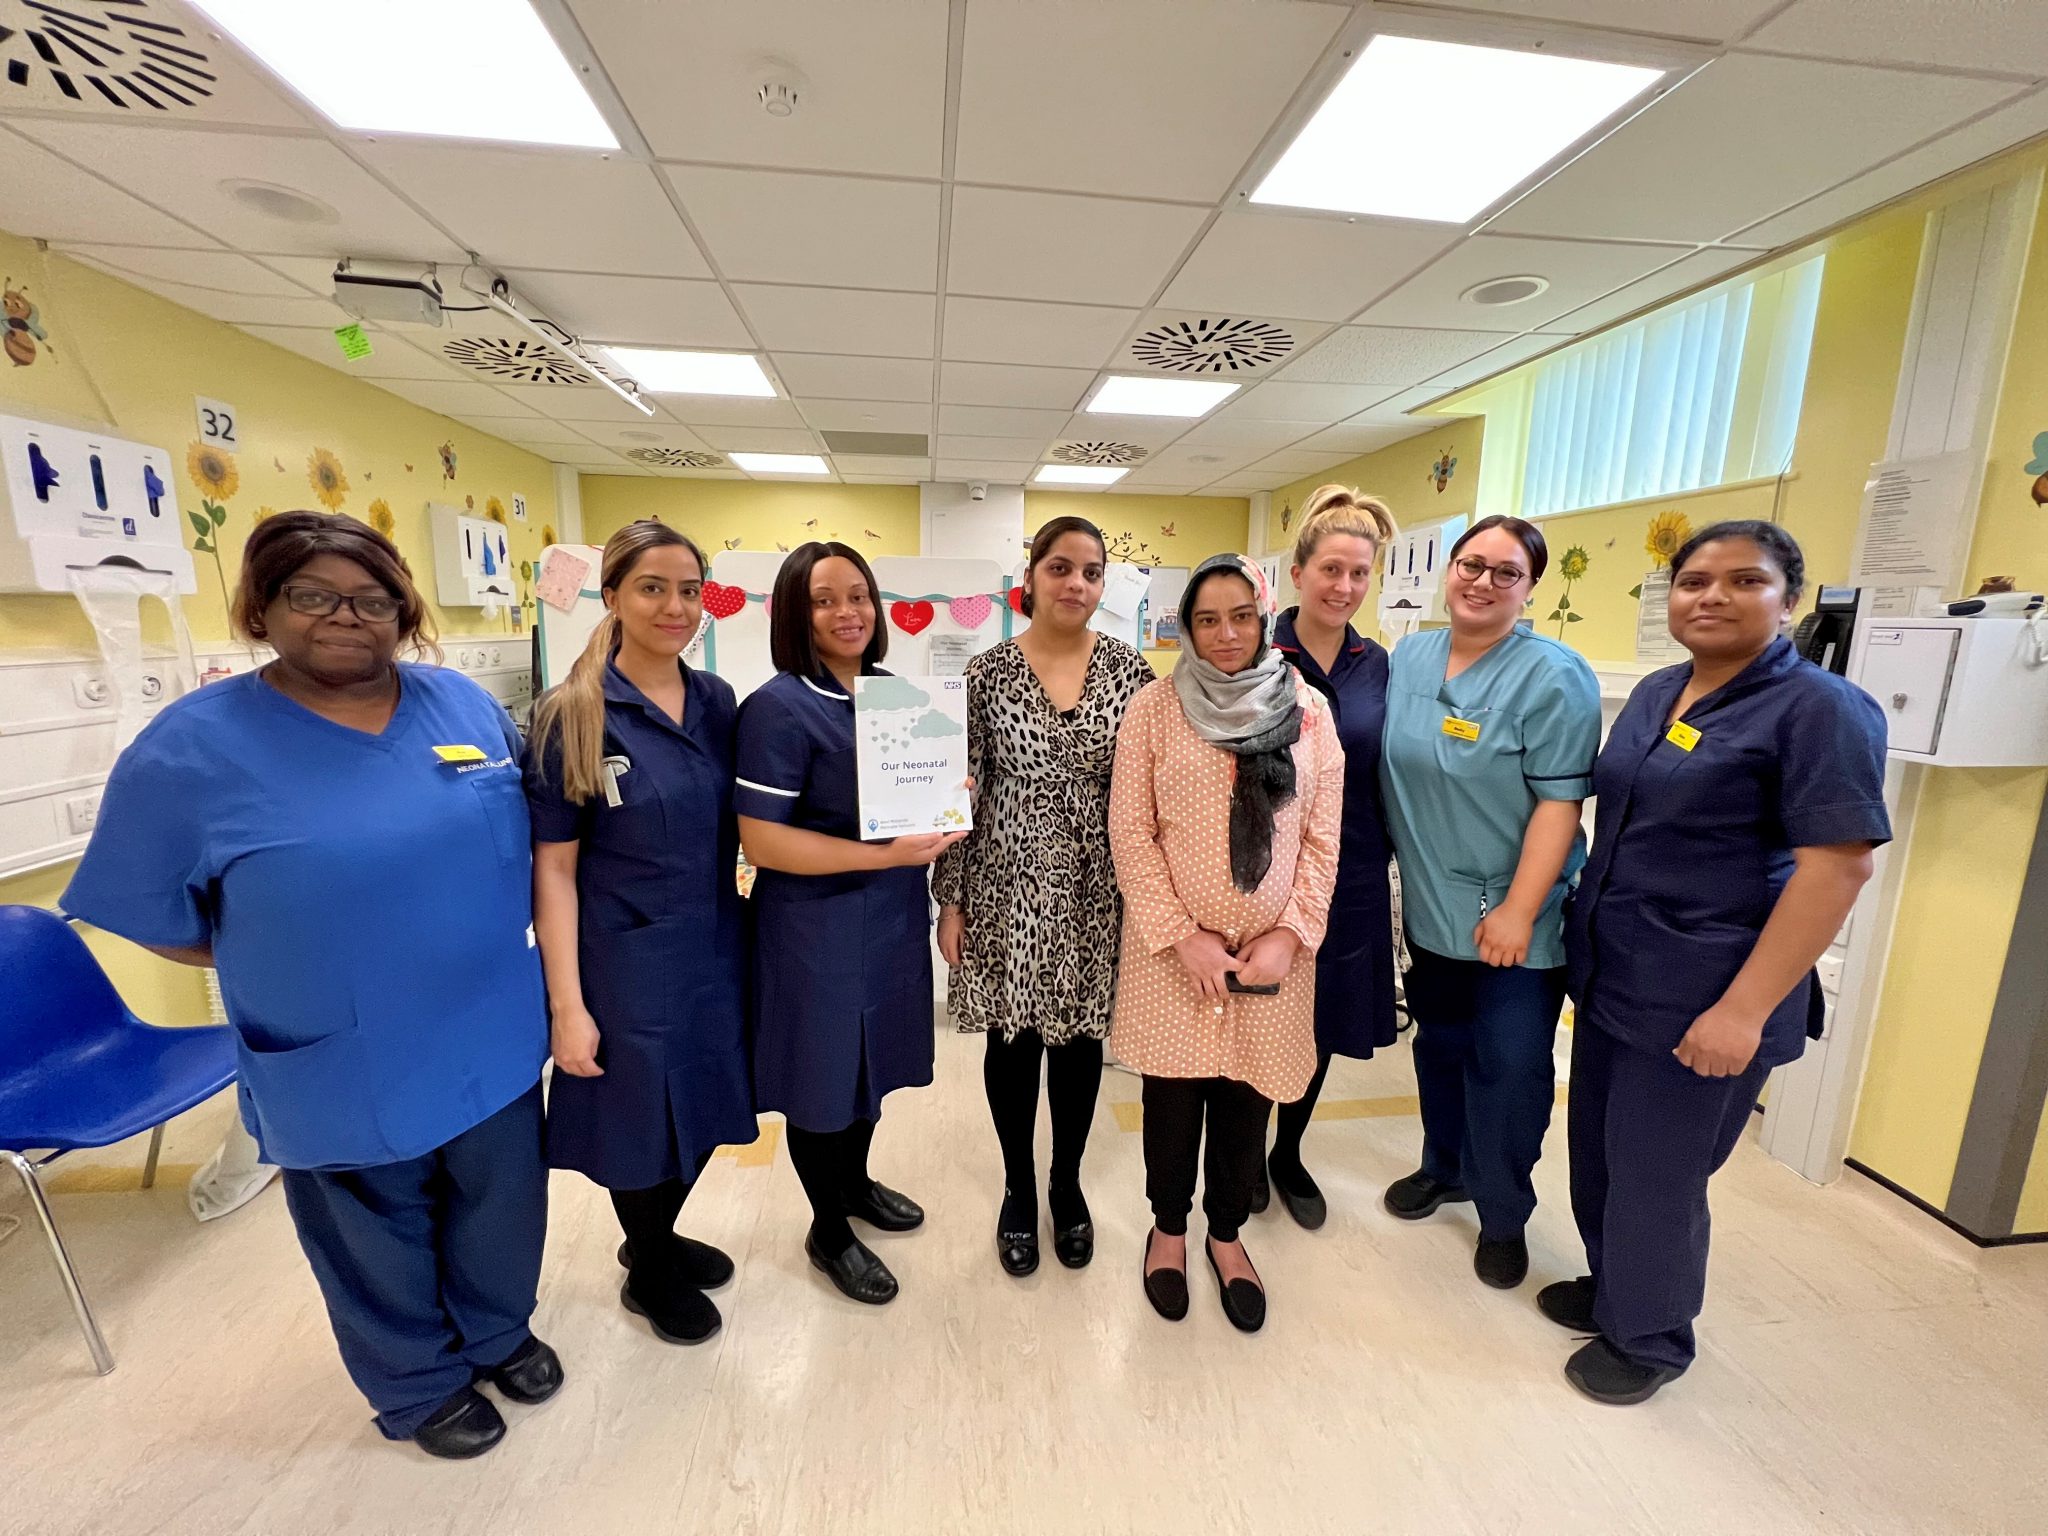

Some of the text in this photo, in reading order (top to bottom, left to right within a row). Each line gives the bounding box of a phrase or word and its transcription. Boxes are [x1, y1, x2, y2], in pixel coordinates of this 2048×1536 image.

[202, 408, 235, 441] 32
[514, 498, 525, 516] 31
[944, 681, 962, 689] NHS
[881, 758, 947, 770] Our Neonatal
[895, 775, 934, 786] Journey
